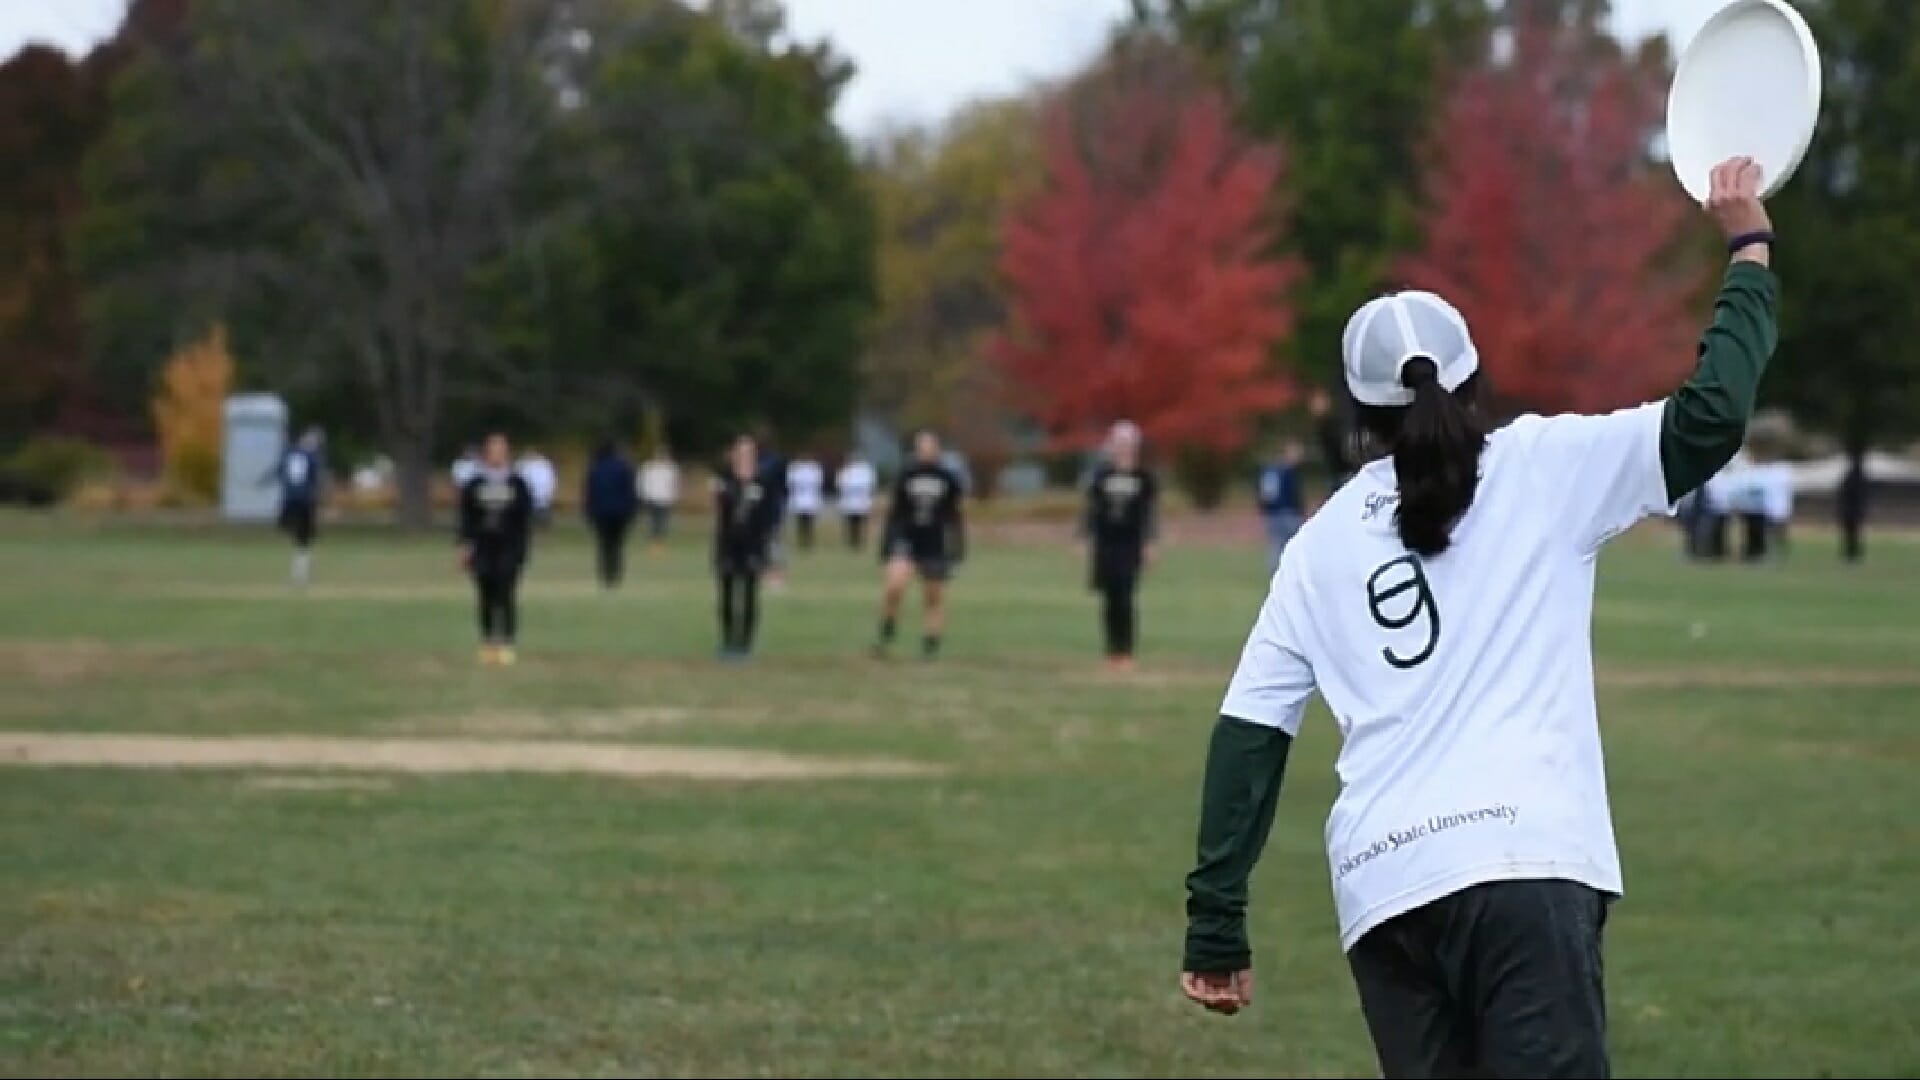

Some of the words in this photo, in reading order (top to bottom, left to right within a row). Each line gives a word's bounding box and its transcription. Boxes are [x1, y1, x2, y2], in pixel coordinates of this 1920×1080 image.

[1337, 841, 1387, 880] olorado
[1388, 824, 1426, 850] State
[1428, 803, 1519, 832] University
